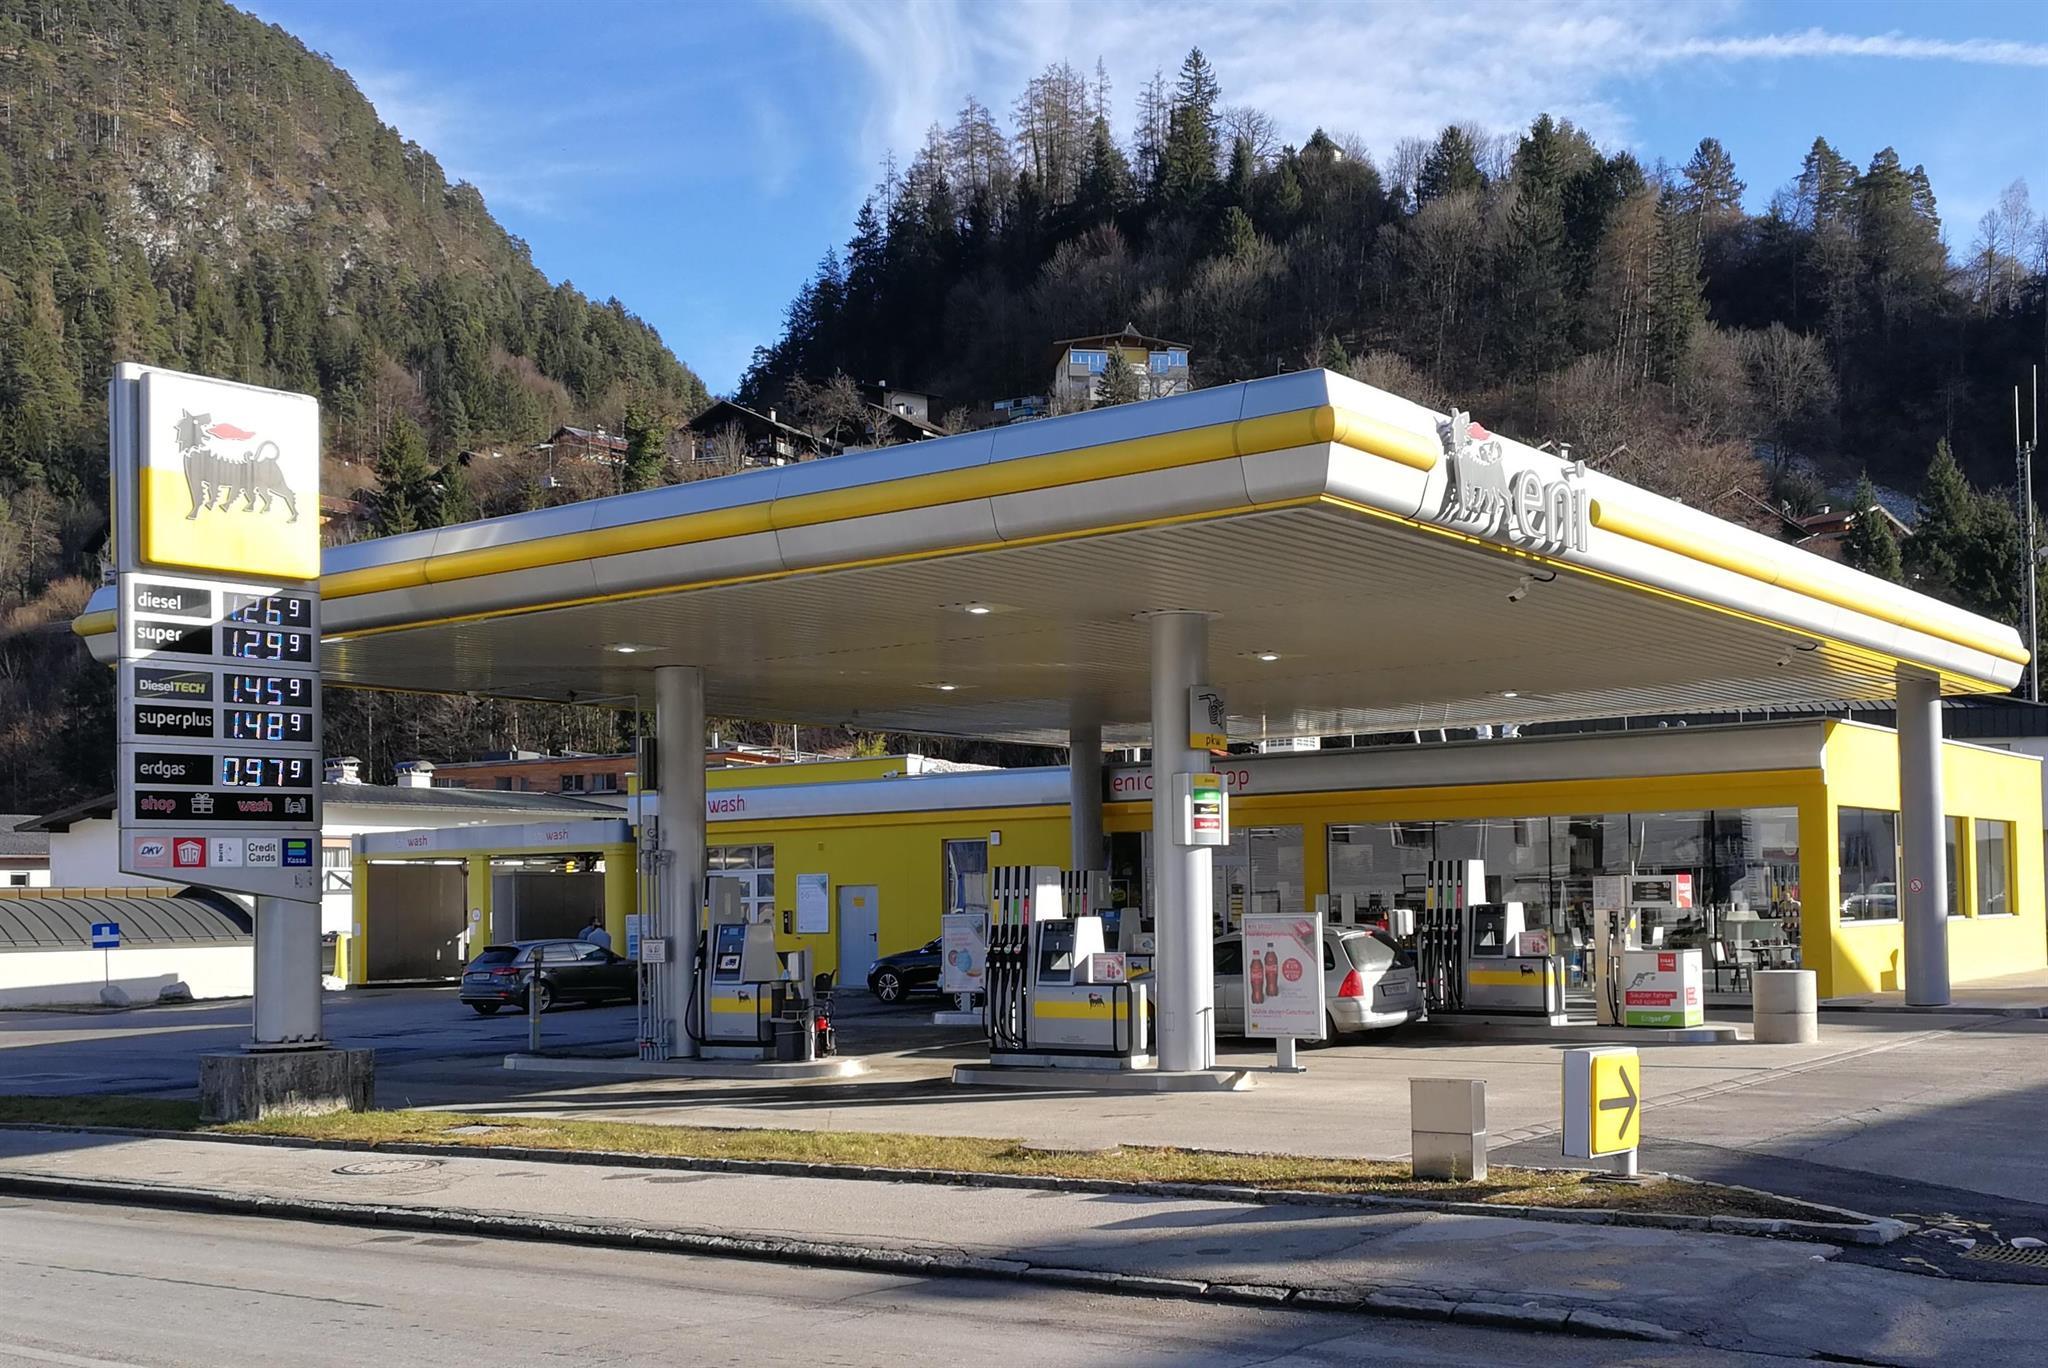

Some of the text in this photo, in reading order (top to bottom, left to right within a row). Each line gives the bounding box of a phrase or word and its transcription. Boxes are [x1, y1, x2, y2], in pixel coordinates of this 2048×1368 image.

[1513, 460, 1588, 552] eni
[137, 591, 182, 610] diesel
[137, 626, 183, 645] super
[139, 679, 206, 694] DieselTECH
[139, 711, 213, 730] superplus
[139, 760, 186, 779] erdgas
[140, 795, 273, 813] shop wash
[707, 793, 746, 813] wash
[407, 835, 428, 847] wash
[545, 829, 569, 841] wash
[140, 846, 163, 855] DKV
[247, 843, 277, 852] Credit
[247, 852, 277, 862] Cards
